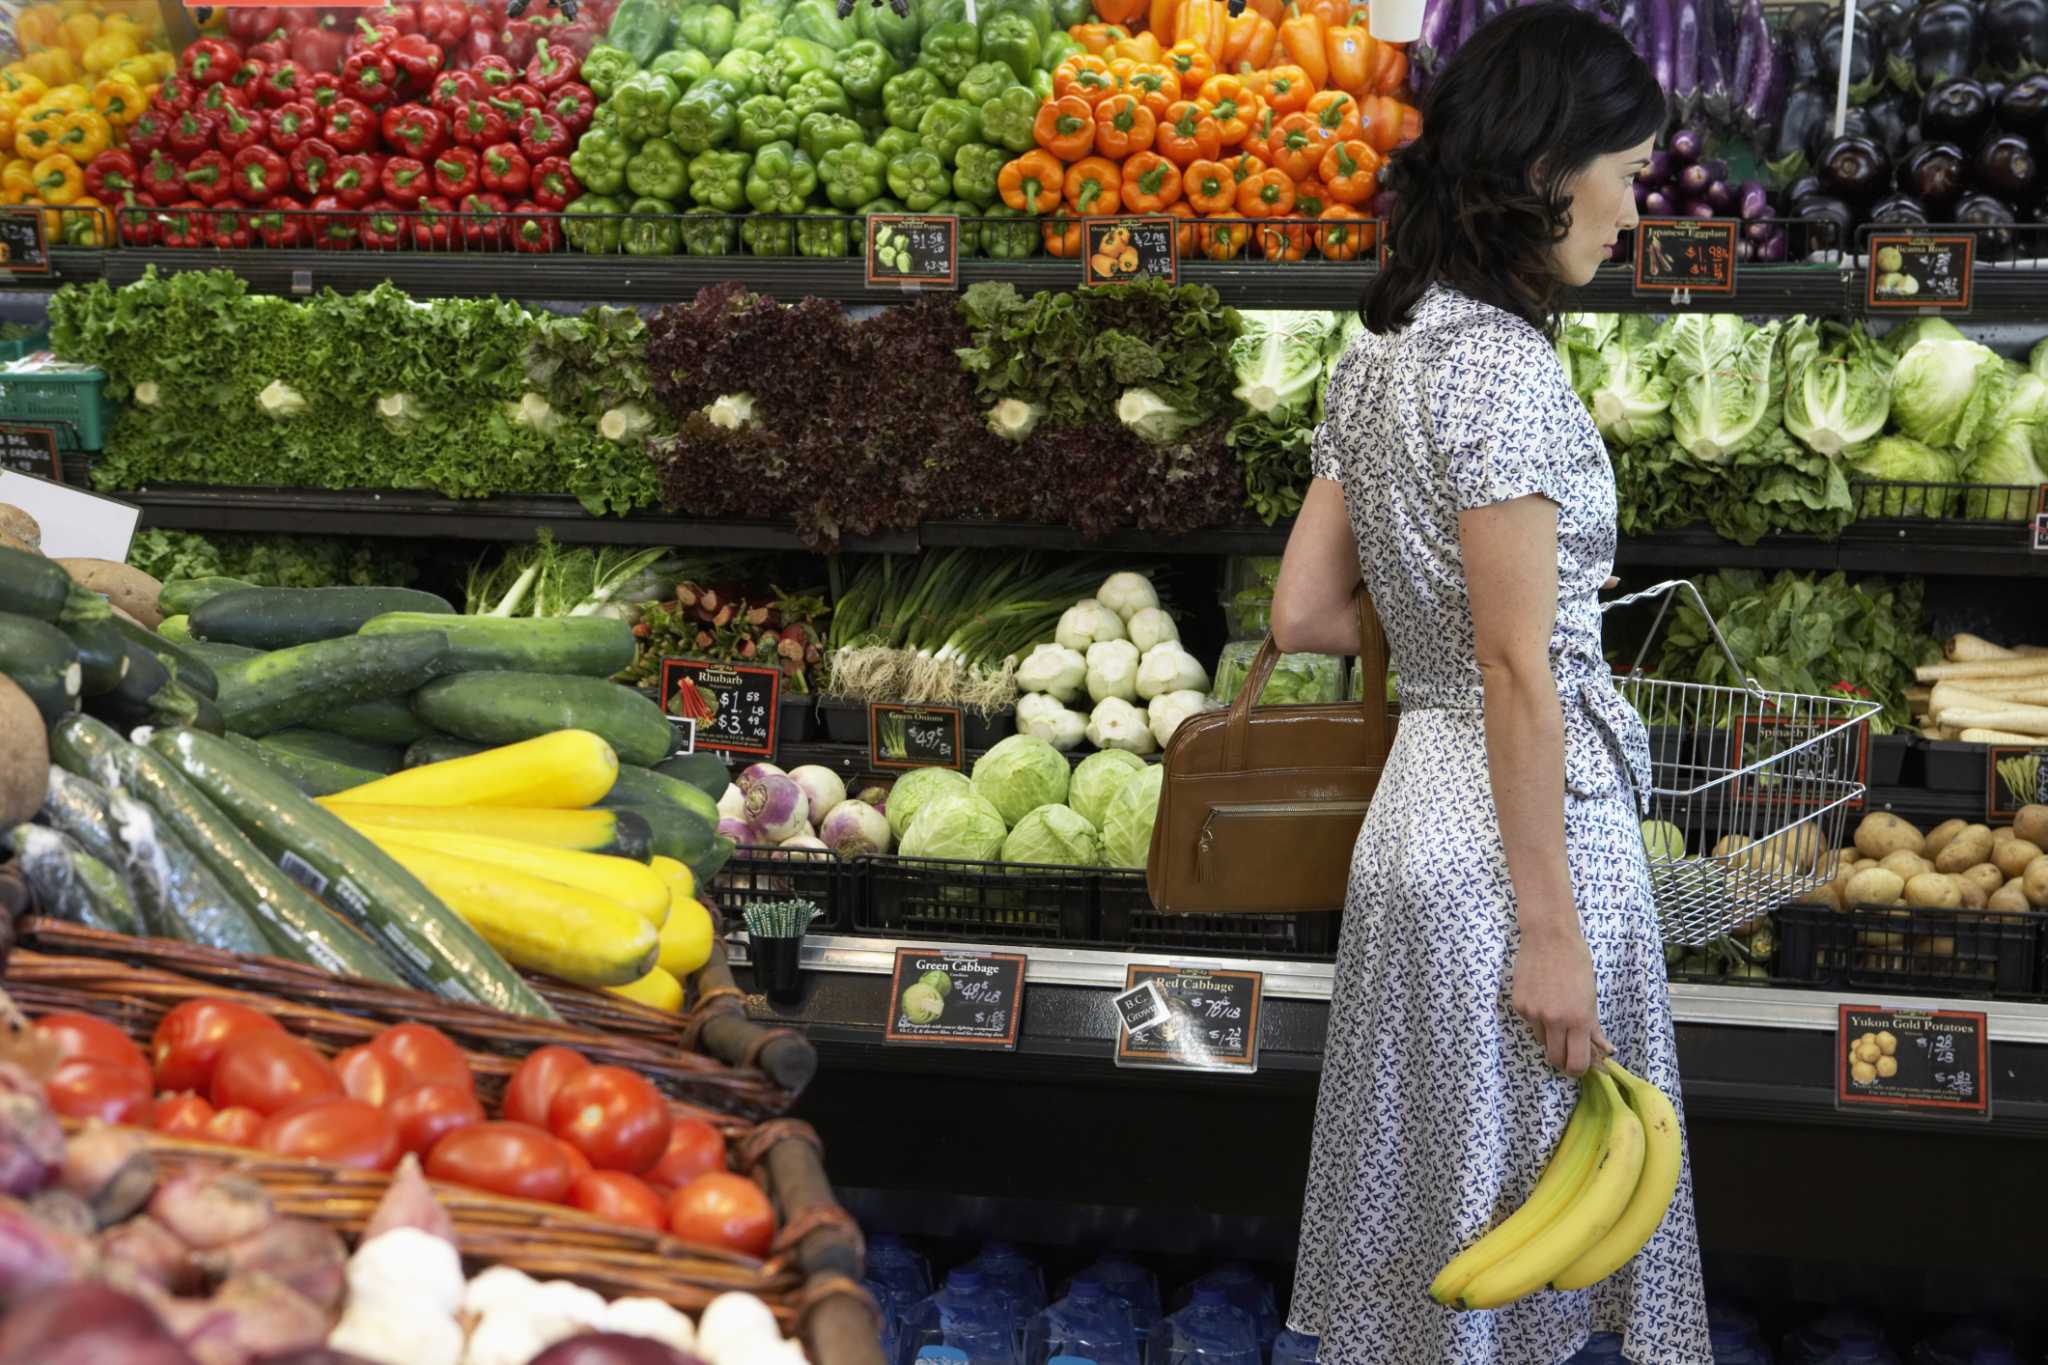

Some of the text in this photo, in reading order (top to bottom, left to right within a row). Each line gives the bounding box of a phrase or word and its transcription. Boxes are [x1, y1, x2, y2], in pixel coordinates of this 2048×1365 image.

[699, 671, 743, 685] Rhubarb
[752, 706, 765, 716] LB
[915, 960, 1000, 976] Green Cabbage
[1156, 977, 1234, 993] Red Cabbage
[1126, 1004, 1158, 1022] Grown
[1851, 1016, 1974, 1033] Yukon Gold Potatoes
